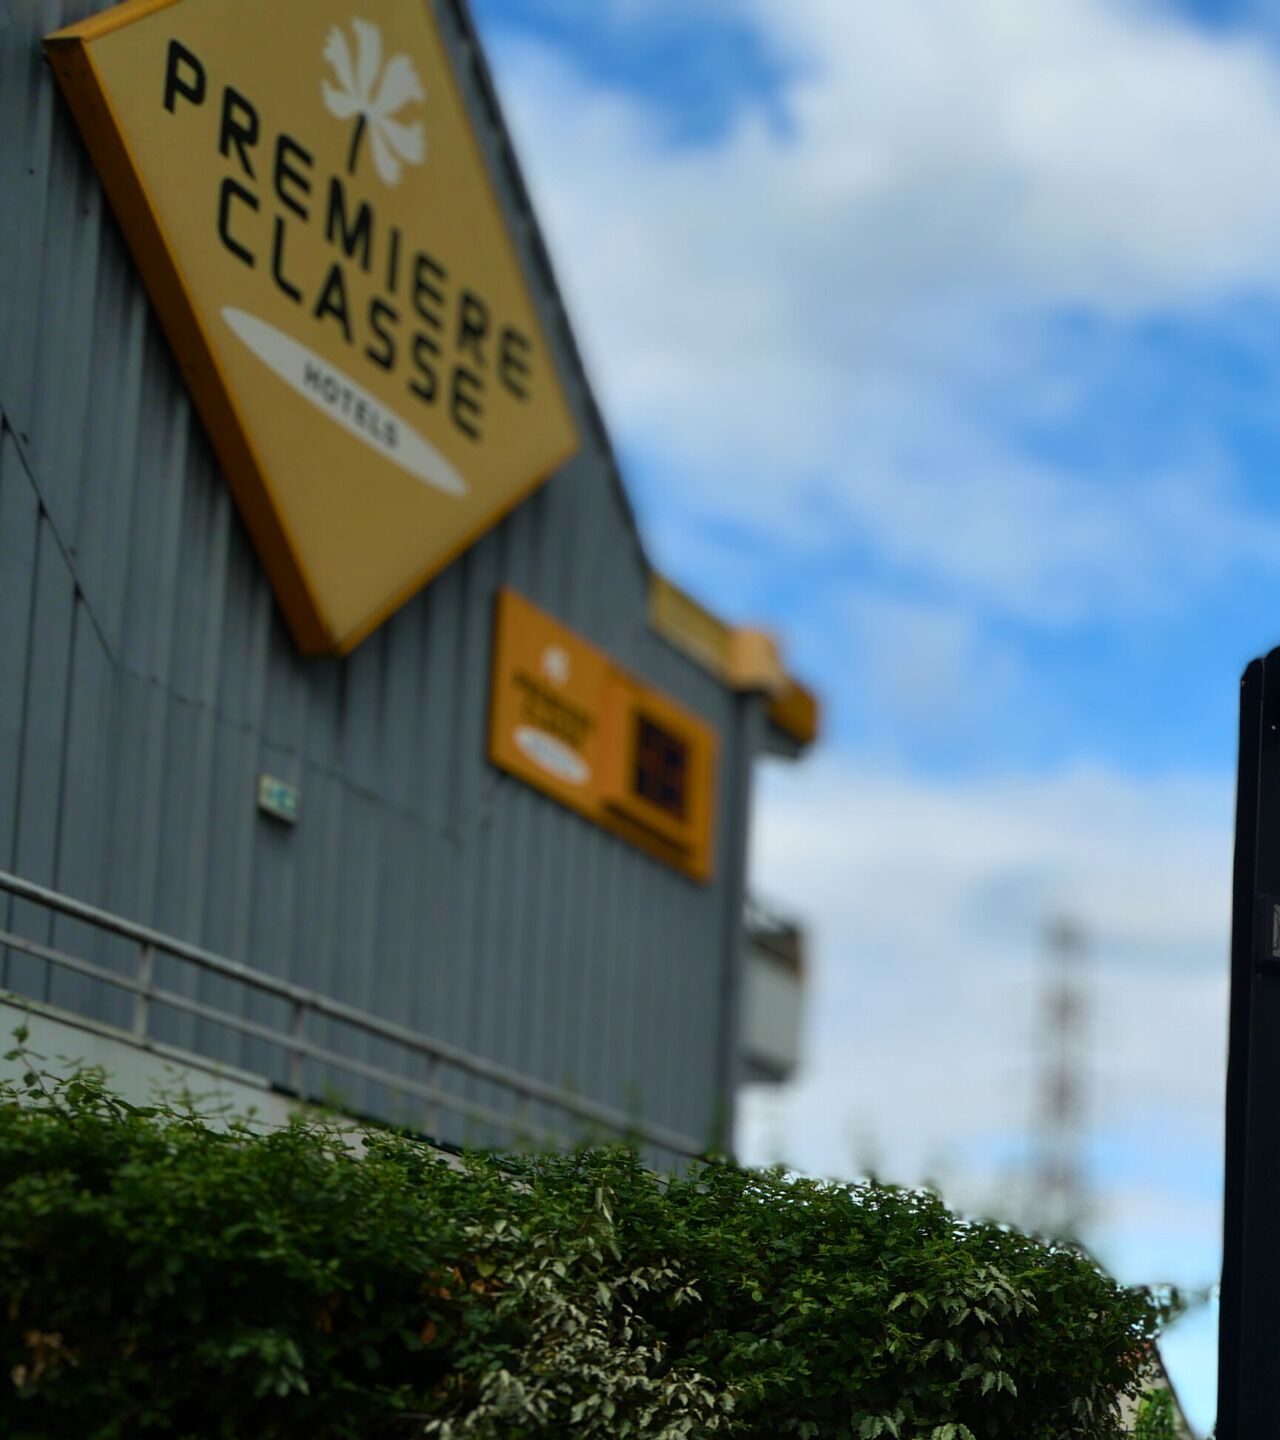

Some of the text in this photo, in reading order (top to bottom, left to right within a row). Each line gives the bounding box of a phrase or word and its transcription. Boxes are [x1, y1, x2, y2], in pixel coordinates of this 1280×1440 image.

[163, 38, 532, 406] PREMIERE
[216, 176, 484, 442] CLASSE
[302, 361, 400, 450] HOTELS
